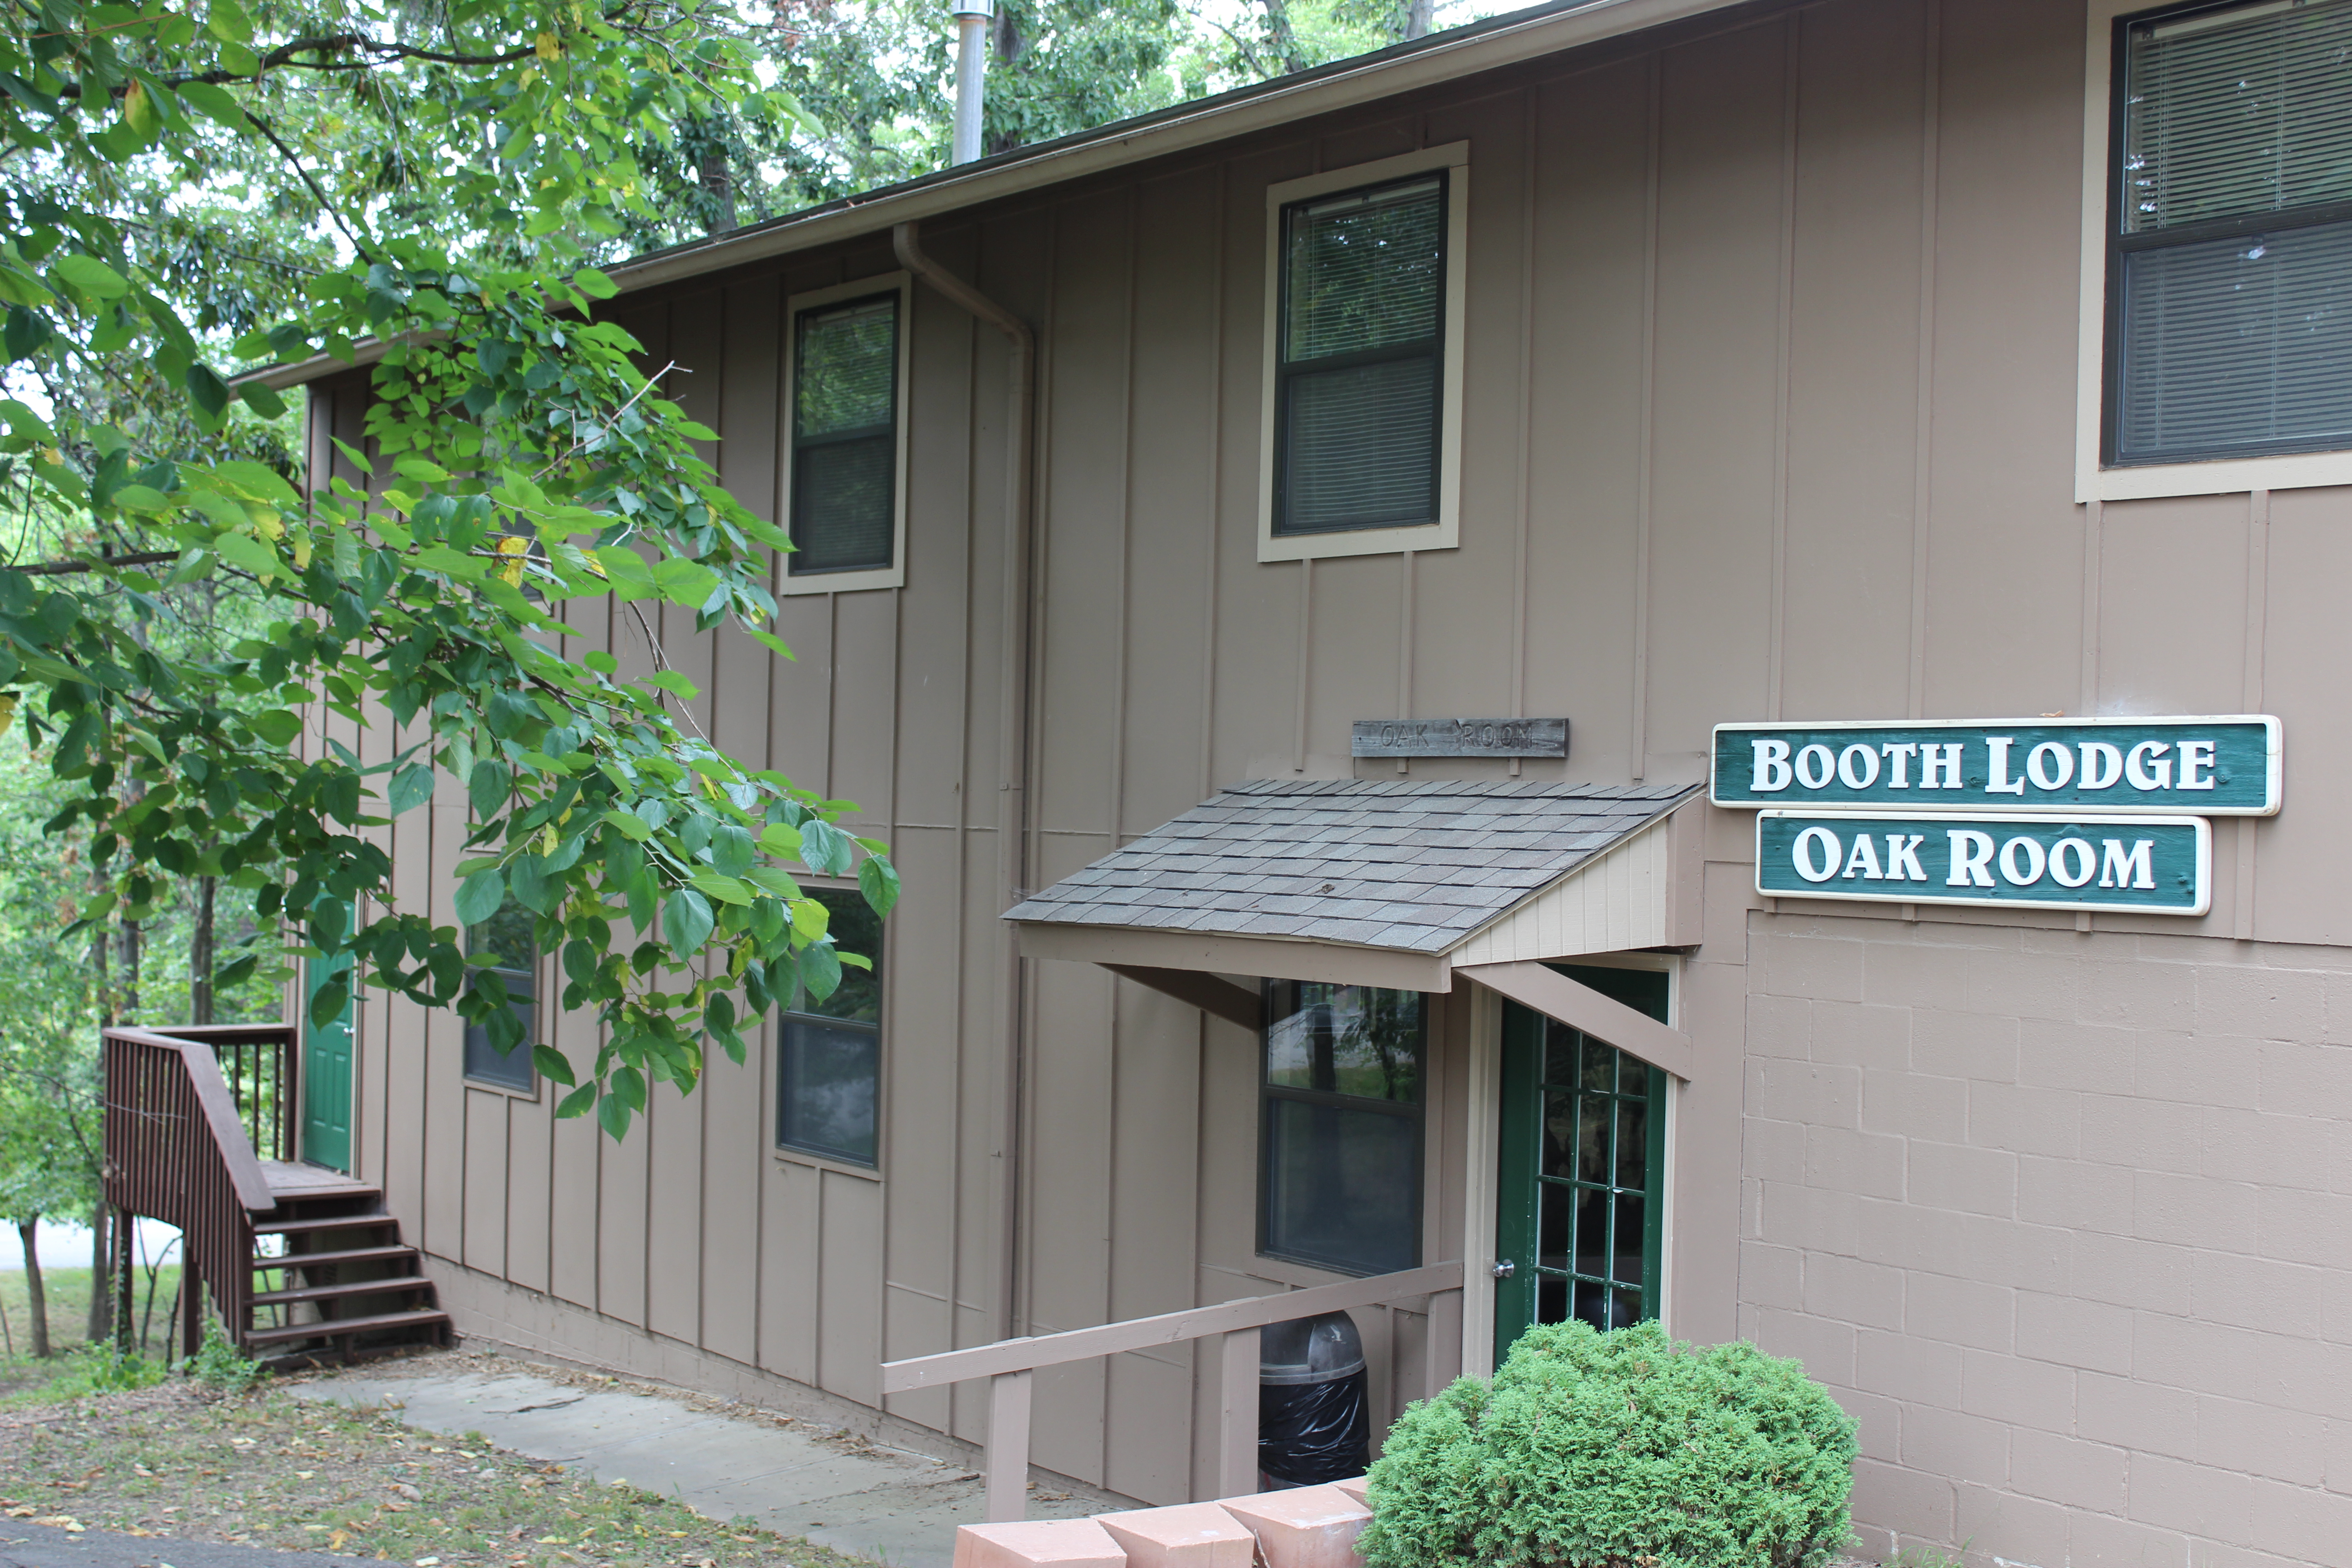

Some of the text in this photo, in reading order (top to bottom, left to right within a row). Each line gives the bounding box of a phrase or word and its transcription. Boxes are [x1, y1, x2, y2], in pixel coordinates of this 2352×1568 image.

[1380, 722, 1533, 749] OAK ROOM
[1749, 736, 2215, 796] BOOTH LODGE
[1792, 826, 2157, 890] OAK ROOM
